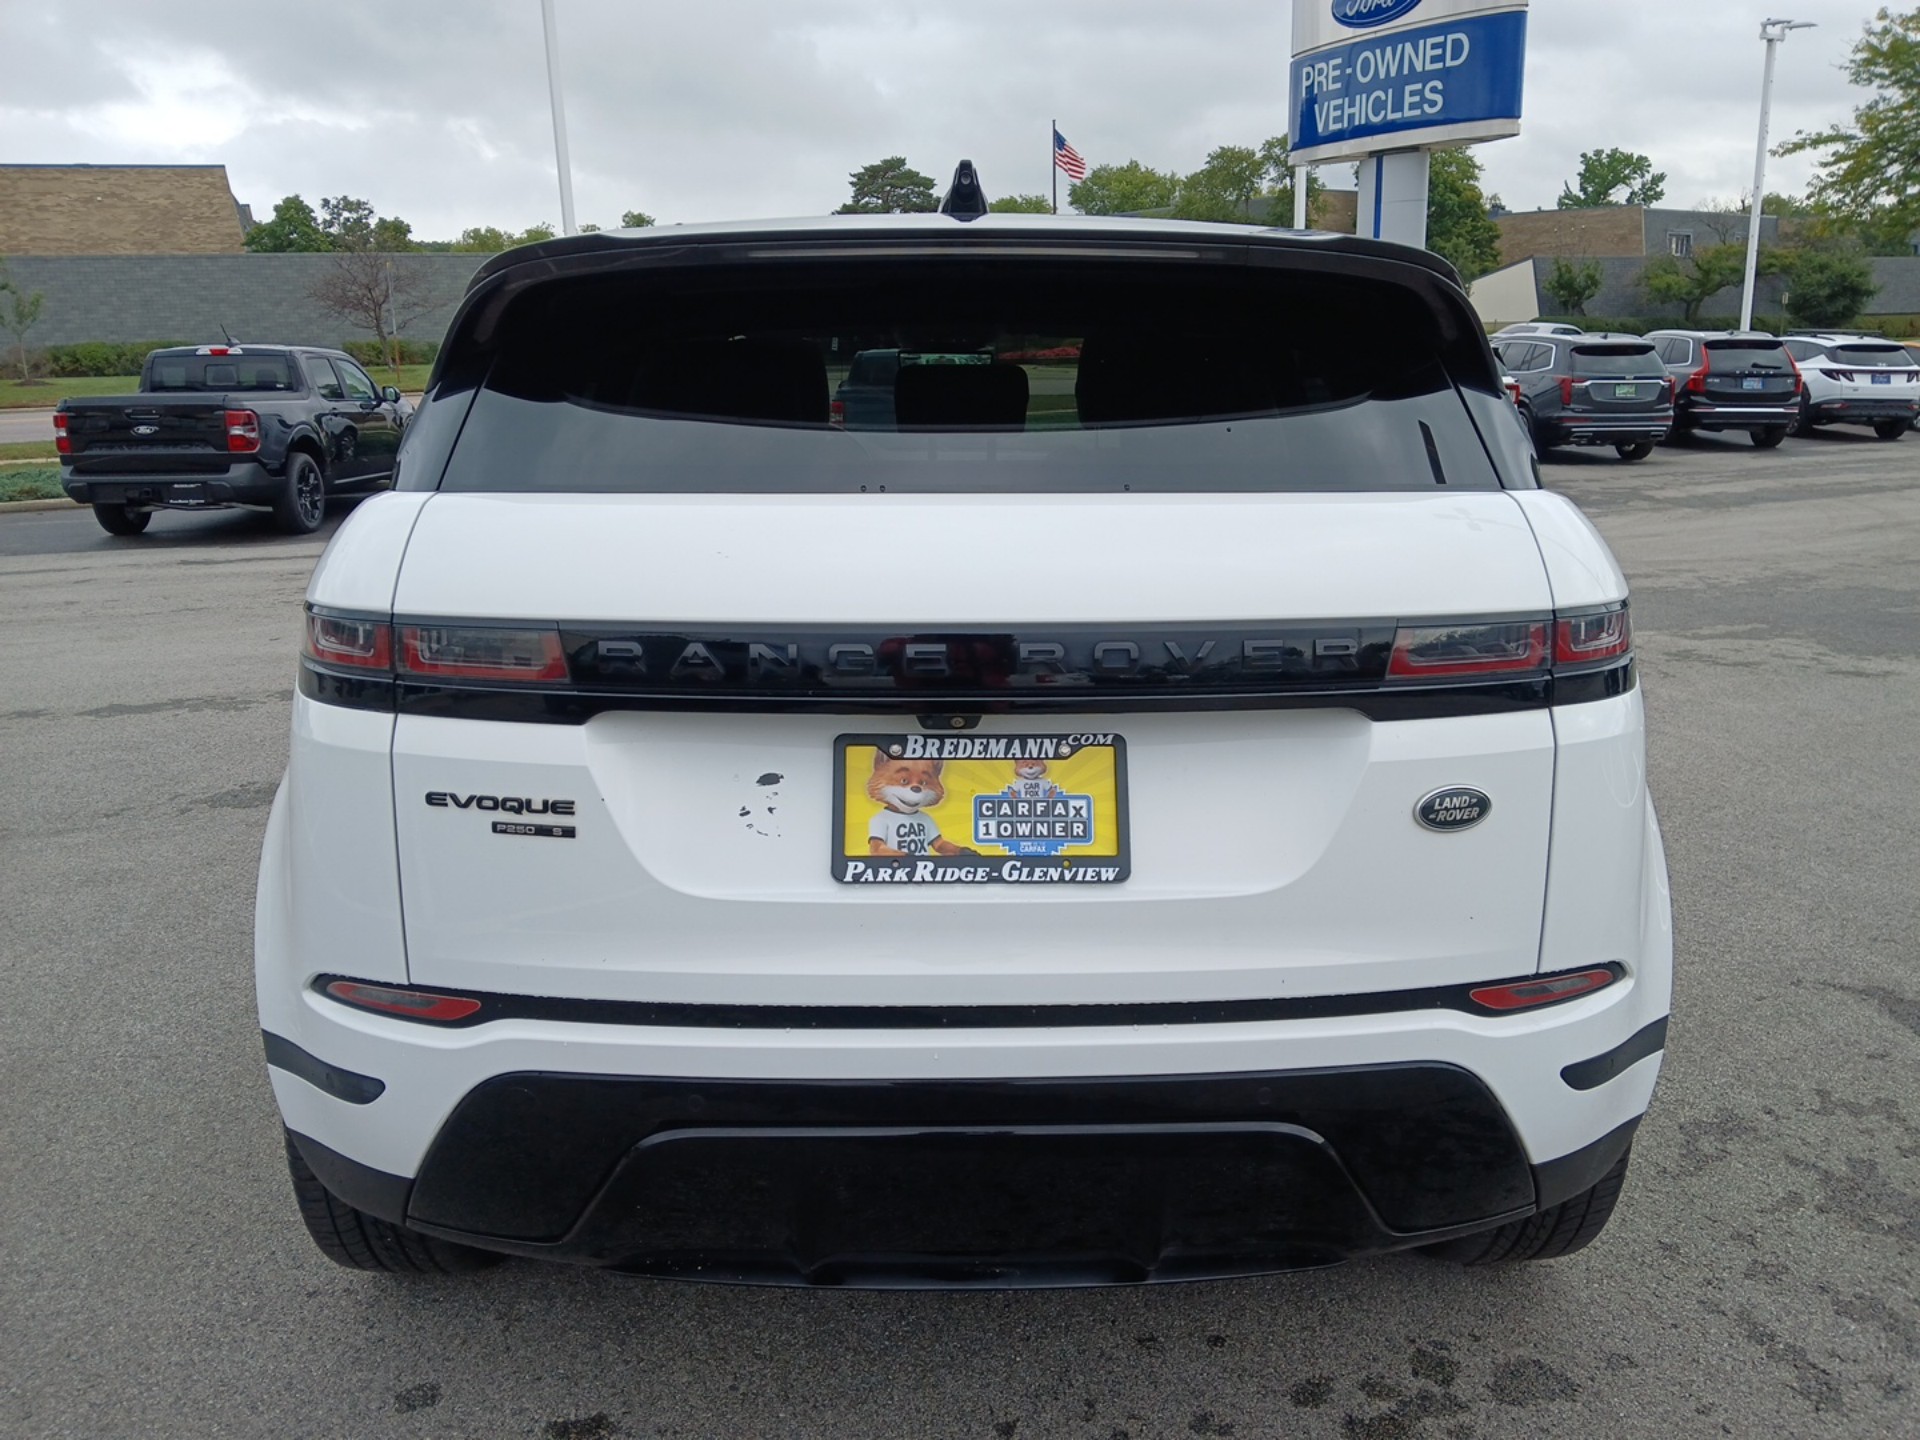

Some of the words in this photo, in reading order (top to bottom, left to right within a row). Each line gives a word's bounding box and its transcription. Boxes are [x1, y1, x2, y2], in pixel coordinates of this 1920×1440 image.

[1302, 32, 1470, 97] PRE-OWNED
[1314, 80, 1443, 133] VEHICLES
[598, 640, 949, 674] RANGE
[1019, 638, 1359, 672] ROVER
[903, 734, 1057, 759] BREDEMANN
[1025, 790, 1040, 798] FOX
[425, 791, 575, 815] EVOQUE
[981, 802, 1084, 818] CARFAX
[1434, 796, 1470, 810] LAND
[1436, 807, 1480, 822] ROVER
[496, 824, 535, 834] P250
[552, 827, 563, 836] S
[896, 823, 926, 838] CAR
[982, 822, 992, 836] 1
[1000, 822, 1084, 836] OWNER
[897, 839, 927, 854] FOX
[844, 861, 911, 882] PARK
